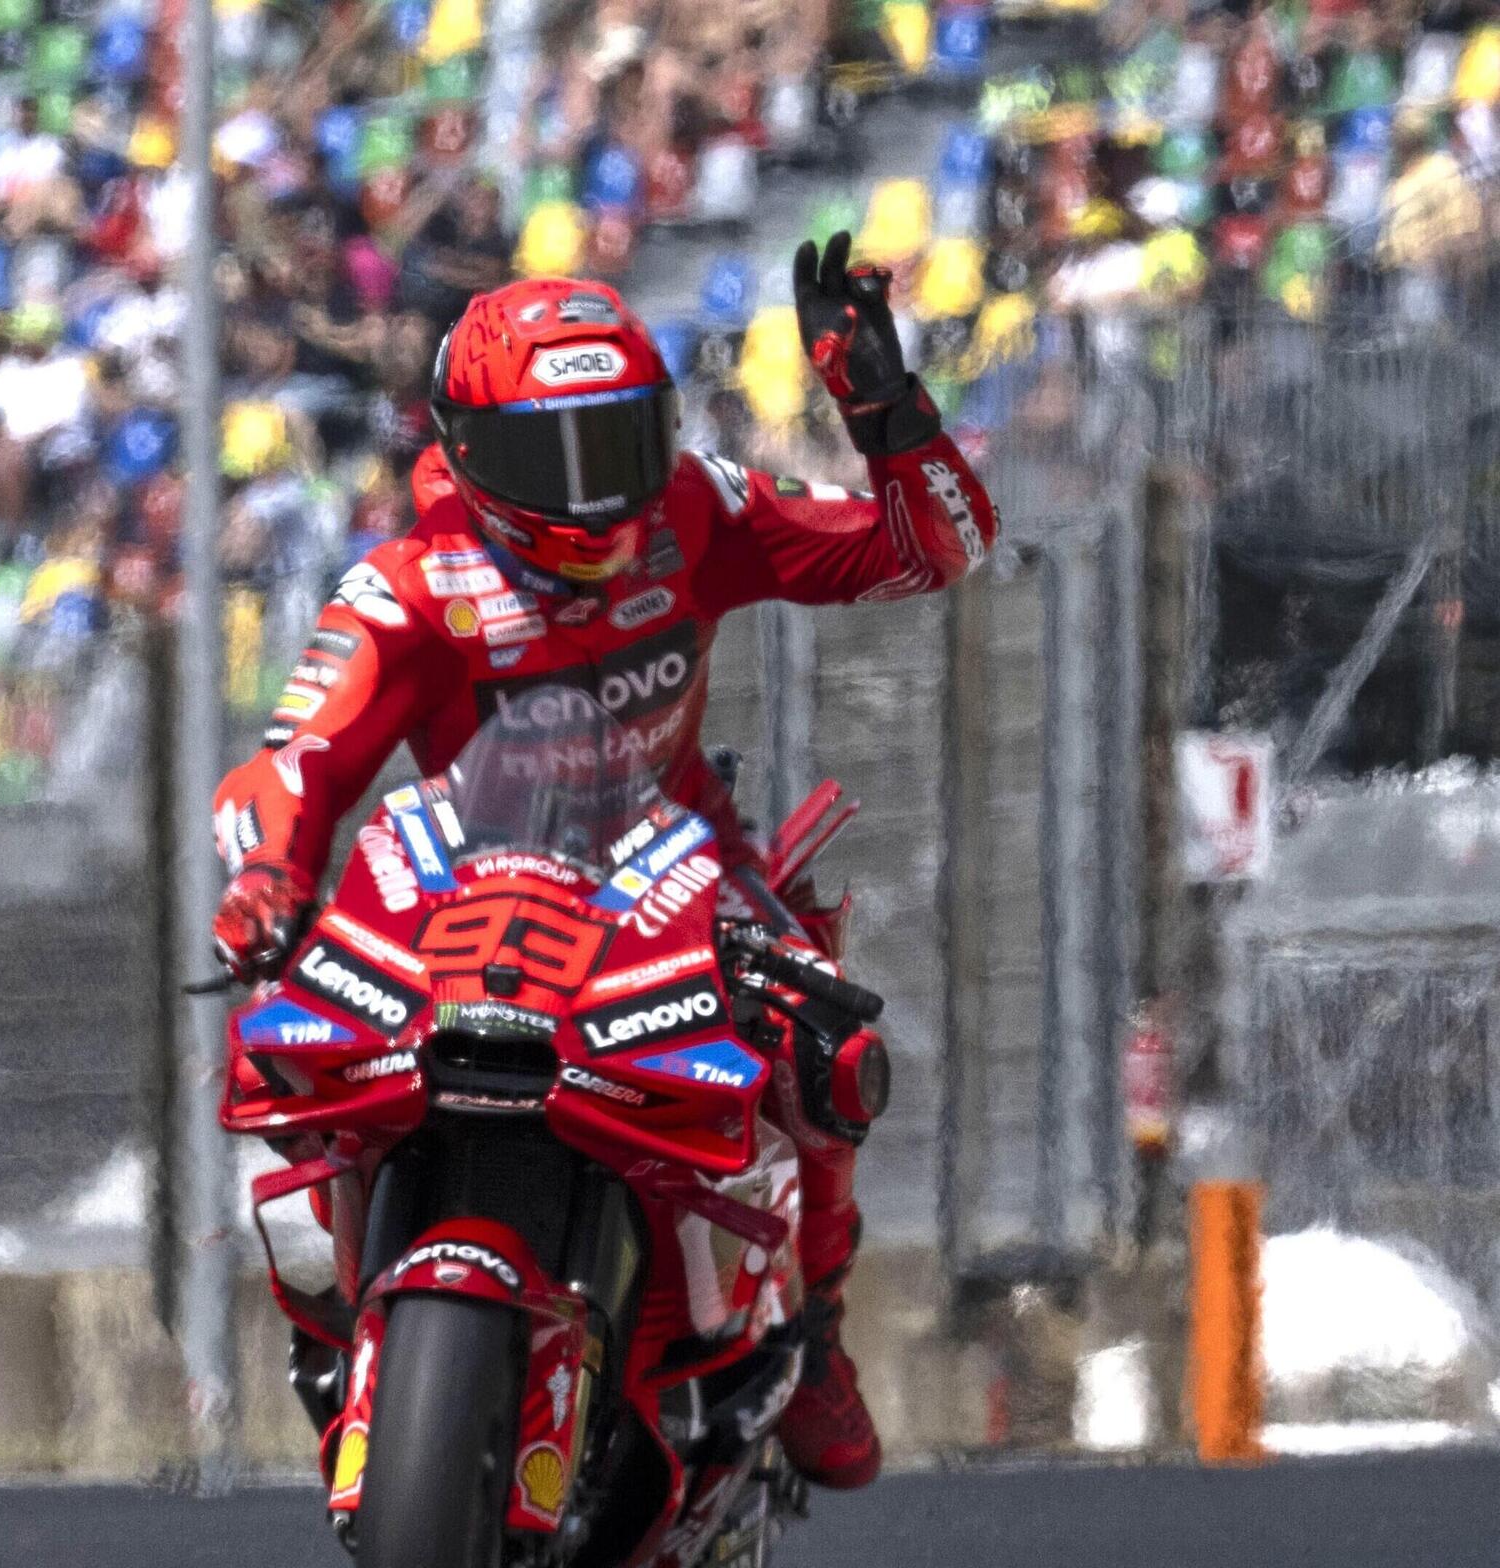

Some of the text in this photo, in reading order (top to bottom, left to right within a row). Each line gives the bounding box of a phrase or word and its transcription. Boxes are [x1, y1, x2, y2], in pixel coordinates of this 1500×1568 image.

[549, 353, 613, 377] SHOEI
[496, 652, 688, 732] Lenovo
[411, 889, 618, 996] 93
[299, 946, 408, 1025] Lenovo
[280, 1023, 332, 1043] TIM
[461, 1003, 557, 1033] MONSTER
[584, 991, 718, 1048] Lenovo
[560, 1066, 647, 1106] CARRERA
[692, 1061, 743, 1088] TIM
[394, 1243, 520, 1287] Lenovo
